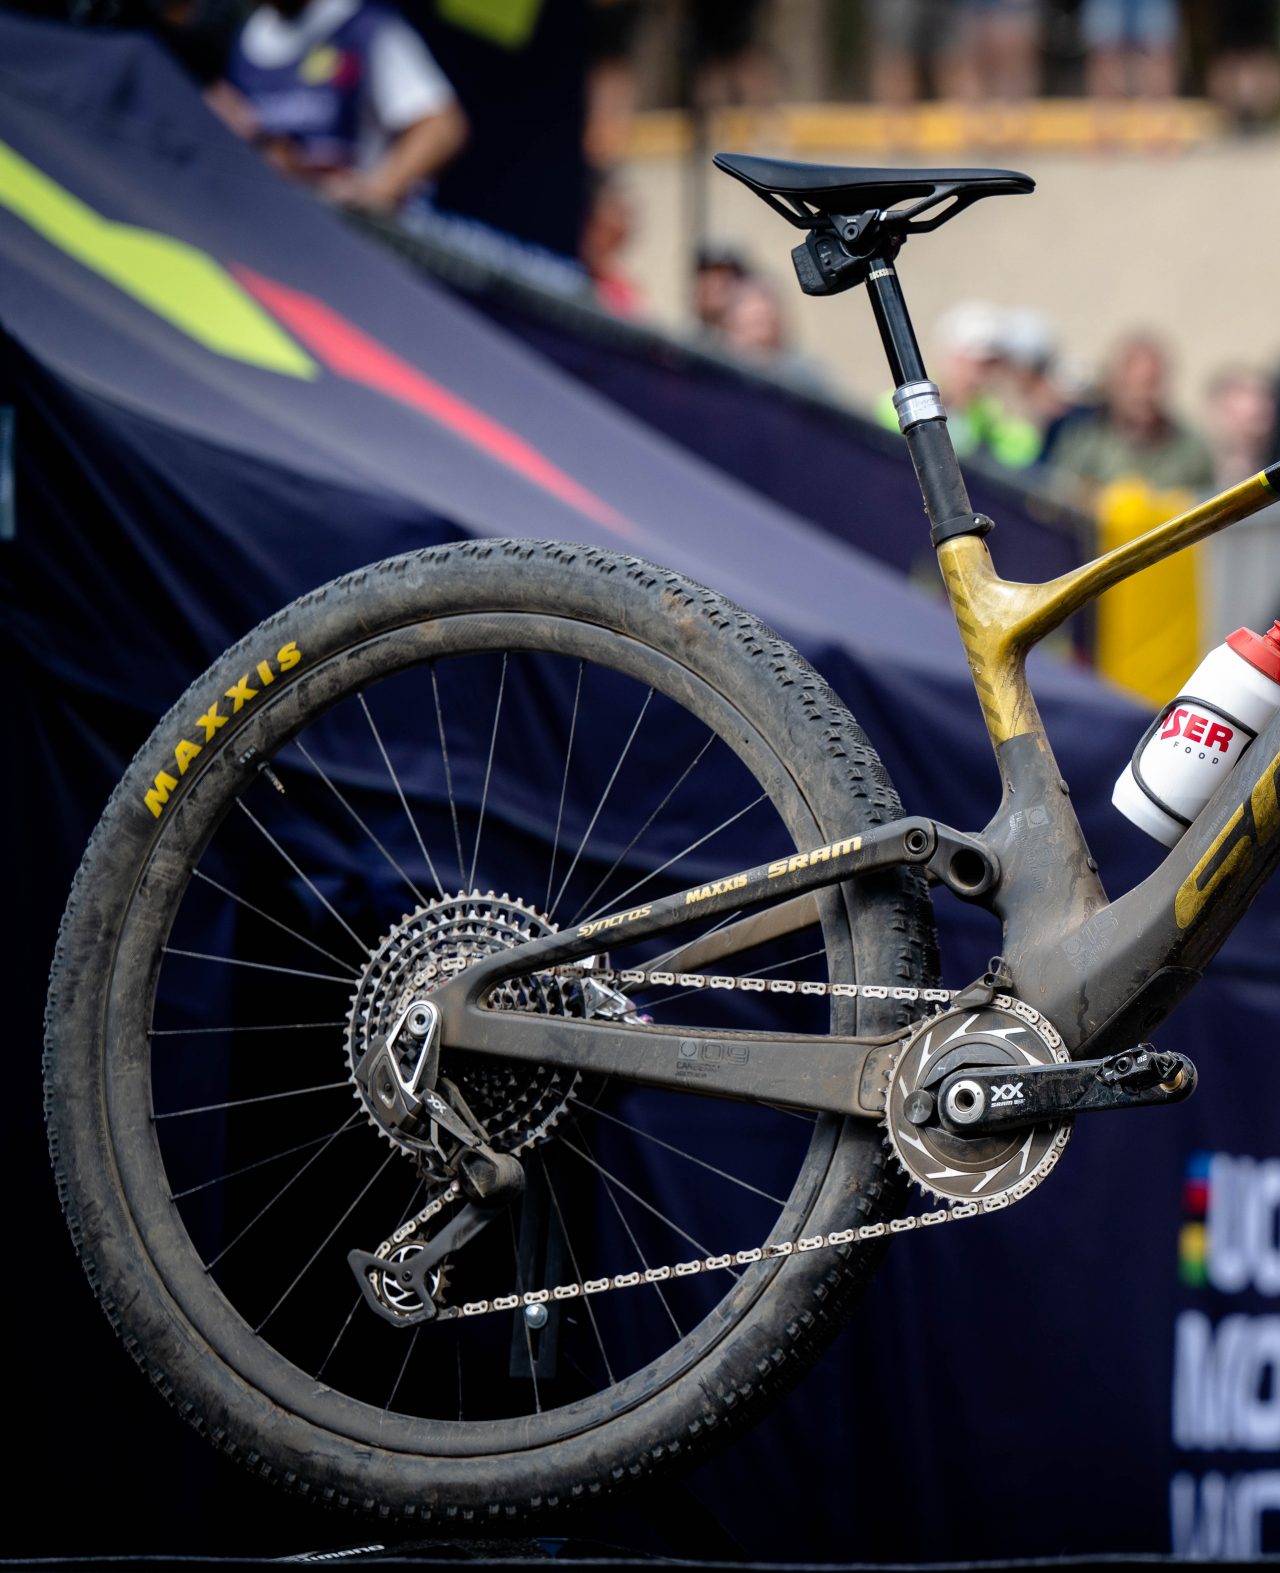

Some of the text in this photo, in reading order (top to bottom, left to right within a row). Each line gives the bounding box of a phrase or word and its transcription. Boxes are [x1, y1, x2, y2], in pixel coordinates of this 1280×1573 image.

[144, 641, 302, 819] MAXXIS
[1173, 741, 1220, 765] FOOD
[685, 874, 748, 905] MAXXIS
[767, 836, 863, 879] SRAM
[990, 1082, 1024, 1102] XX
[427, 1094, 448, 1115] XX
